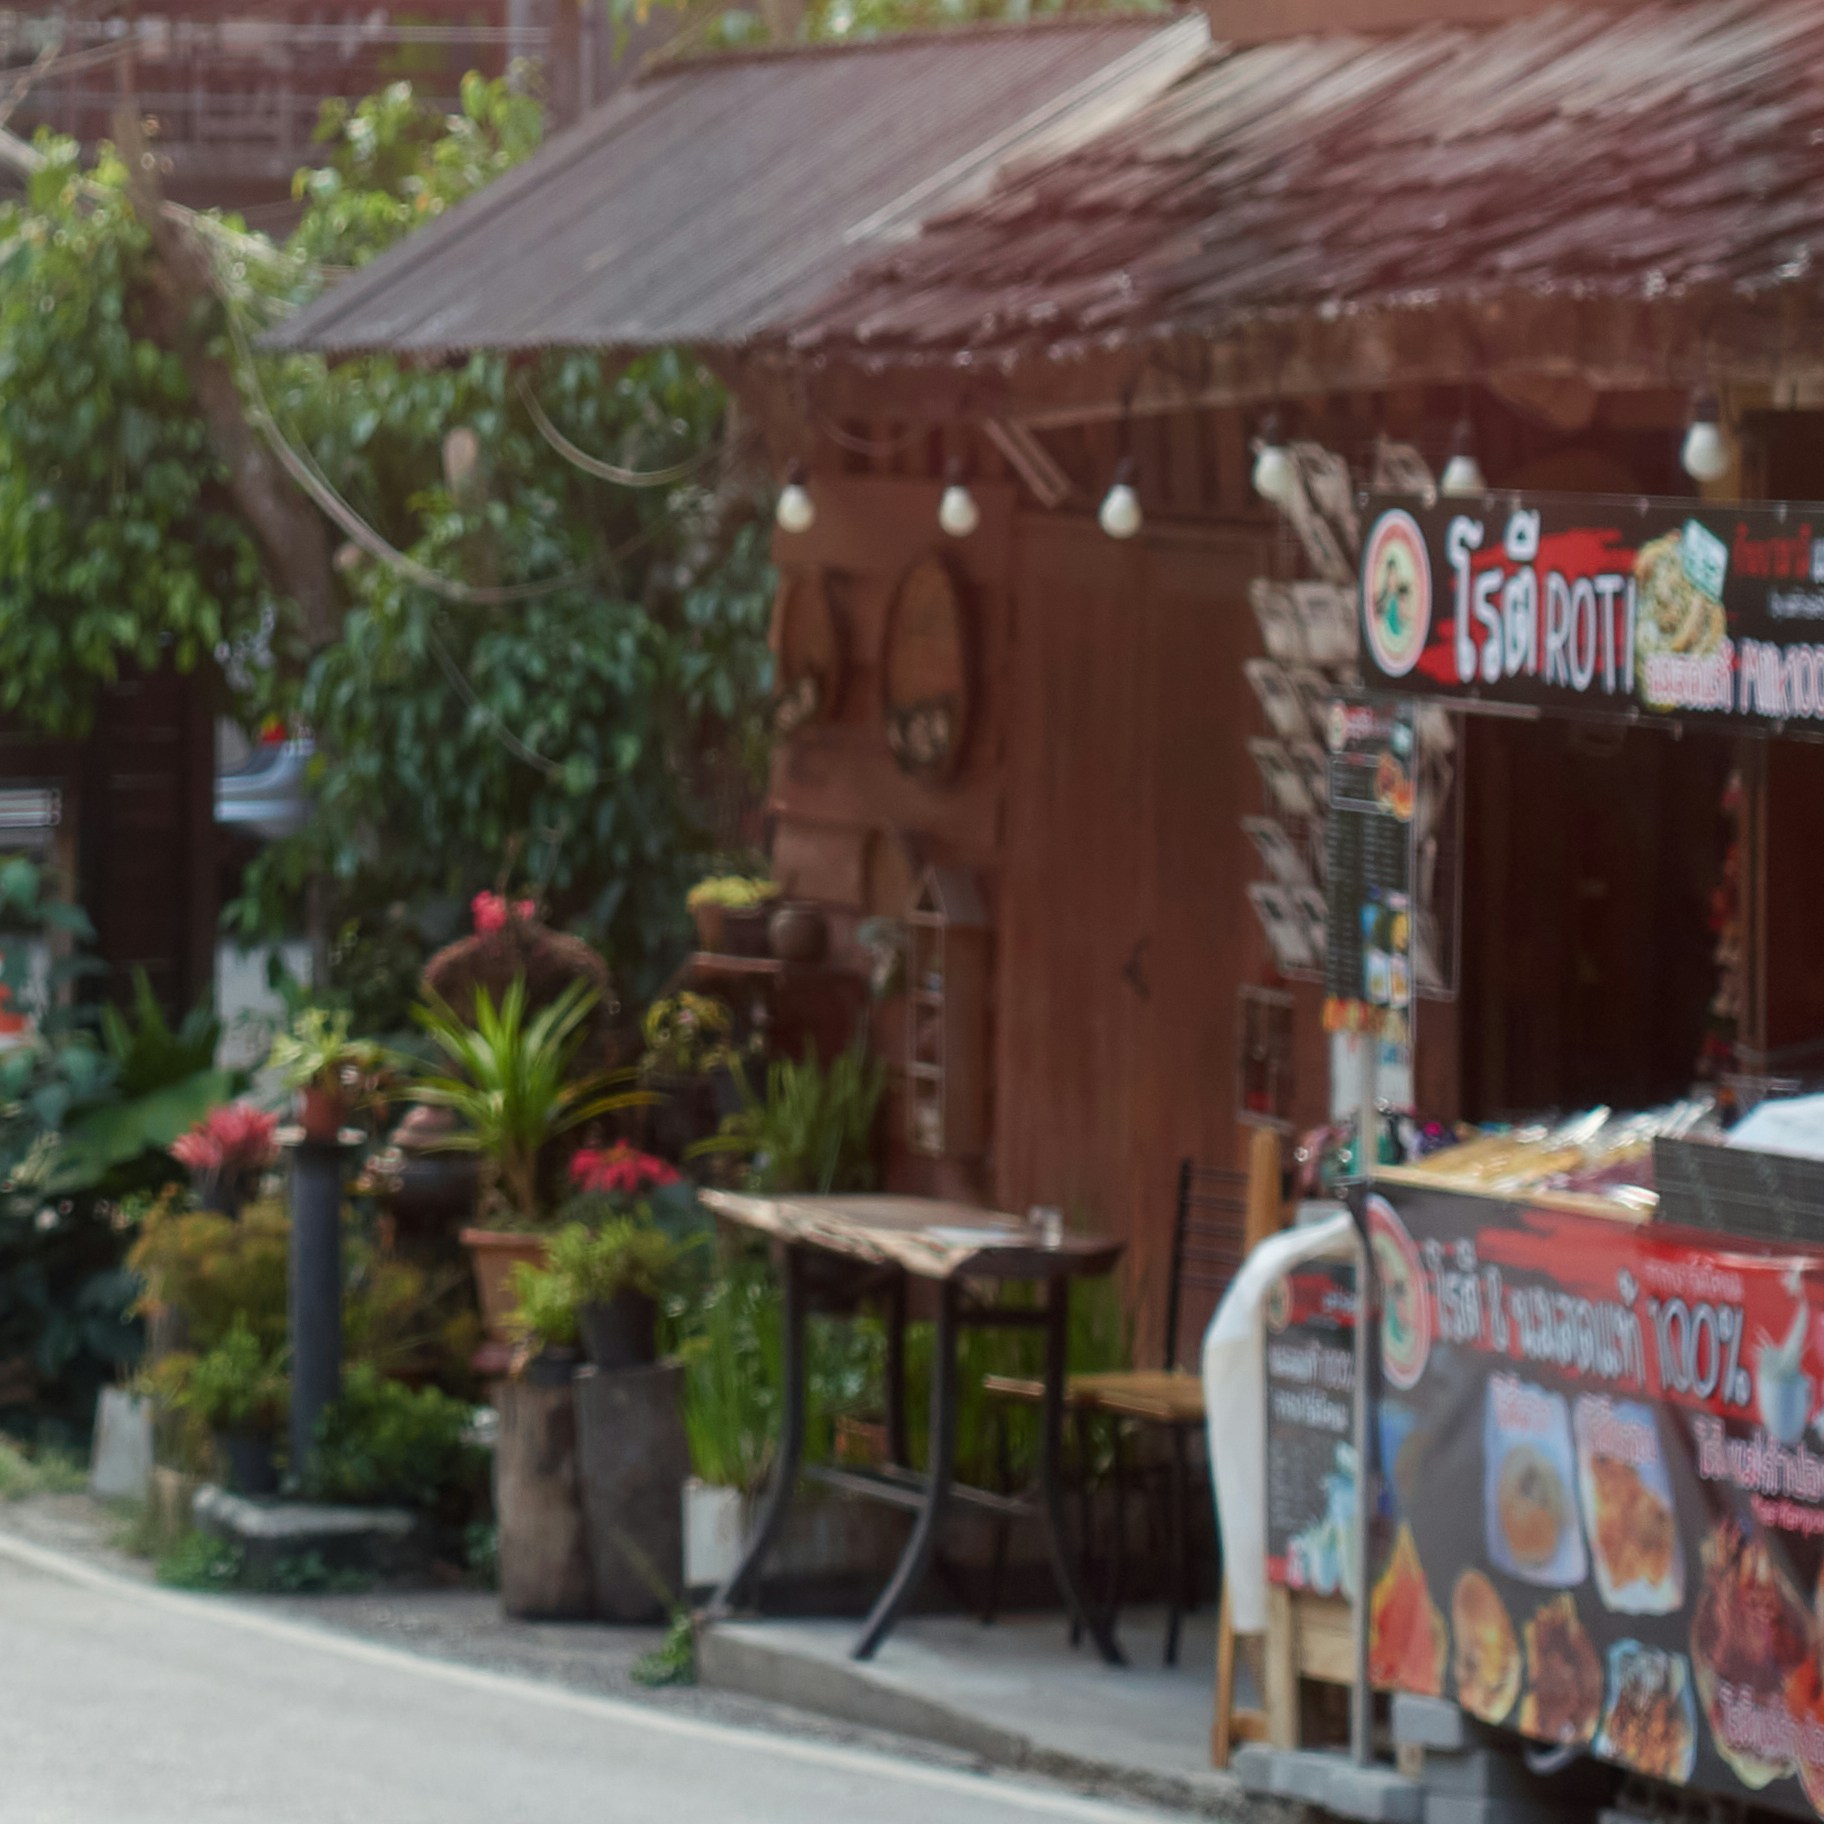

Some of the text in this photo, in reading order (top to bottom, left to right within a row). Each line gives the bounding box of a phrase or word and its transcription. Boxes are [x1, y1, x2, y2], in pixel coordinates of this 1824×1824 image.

[1445, 509, 1636, 694] โรตี ROTI
[1422, 1237, 1480, 1344] โรตี
[1646, 1293, 1751, 1408] 100%
